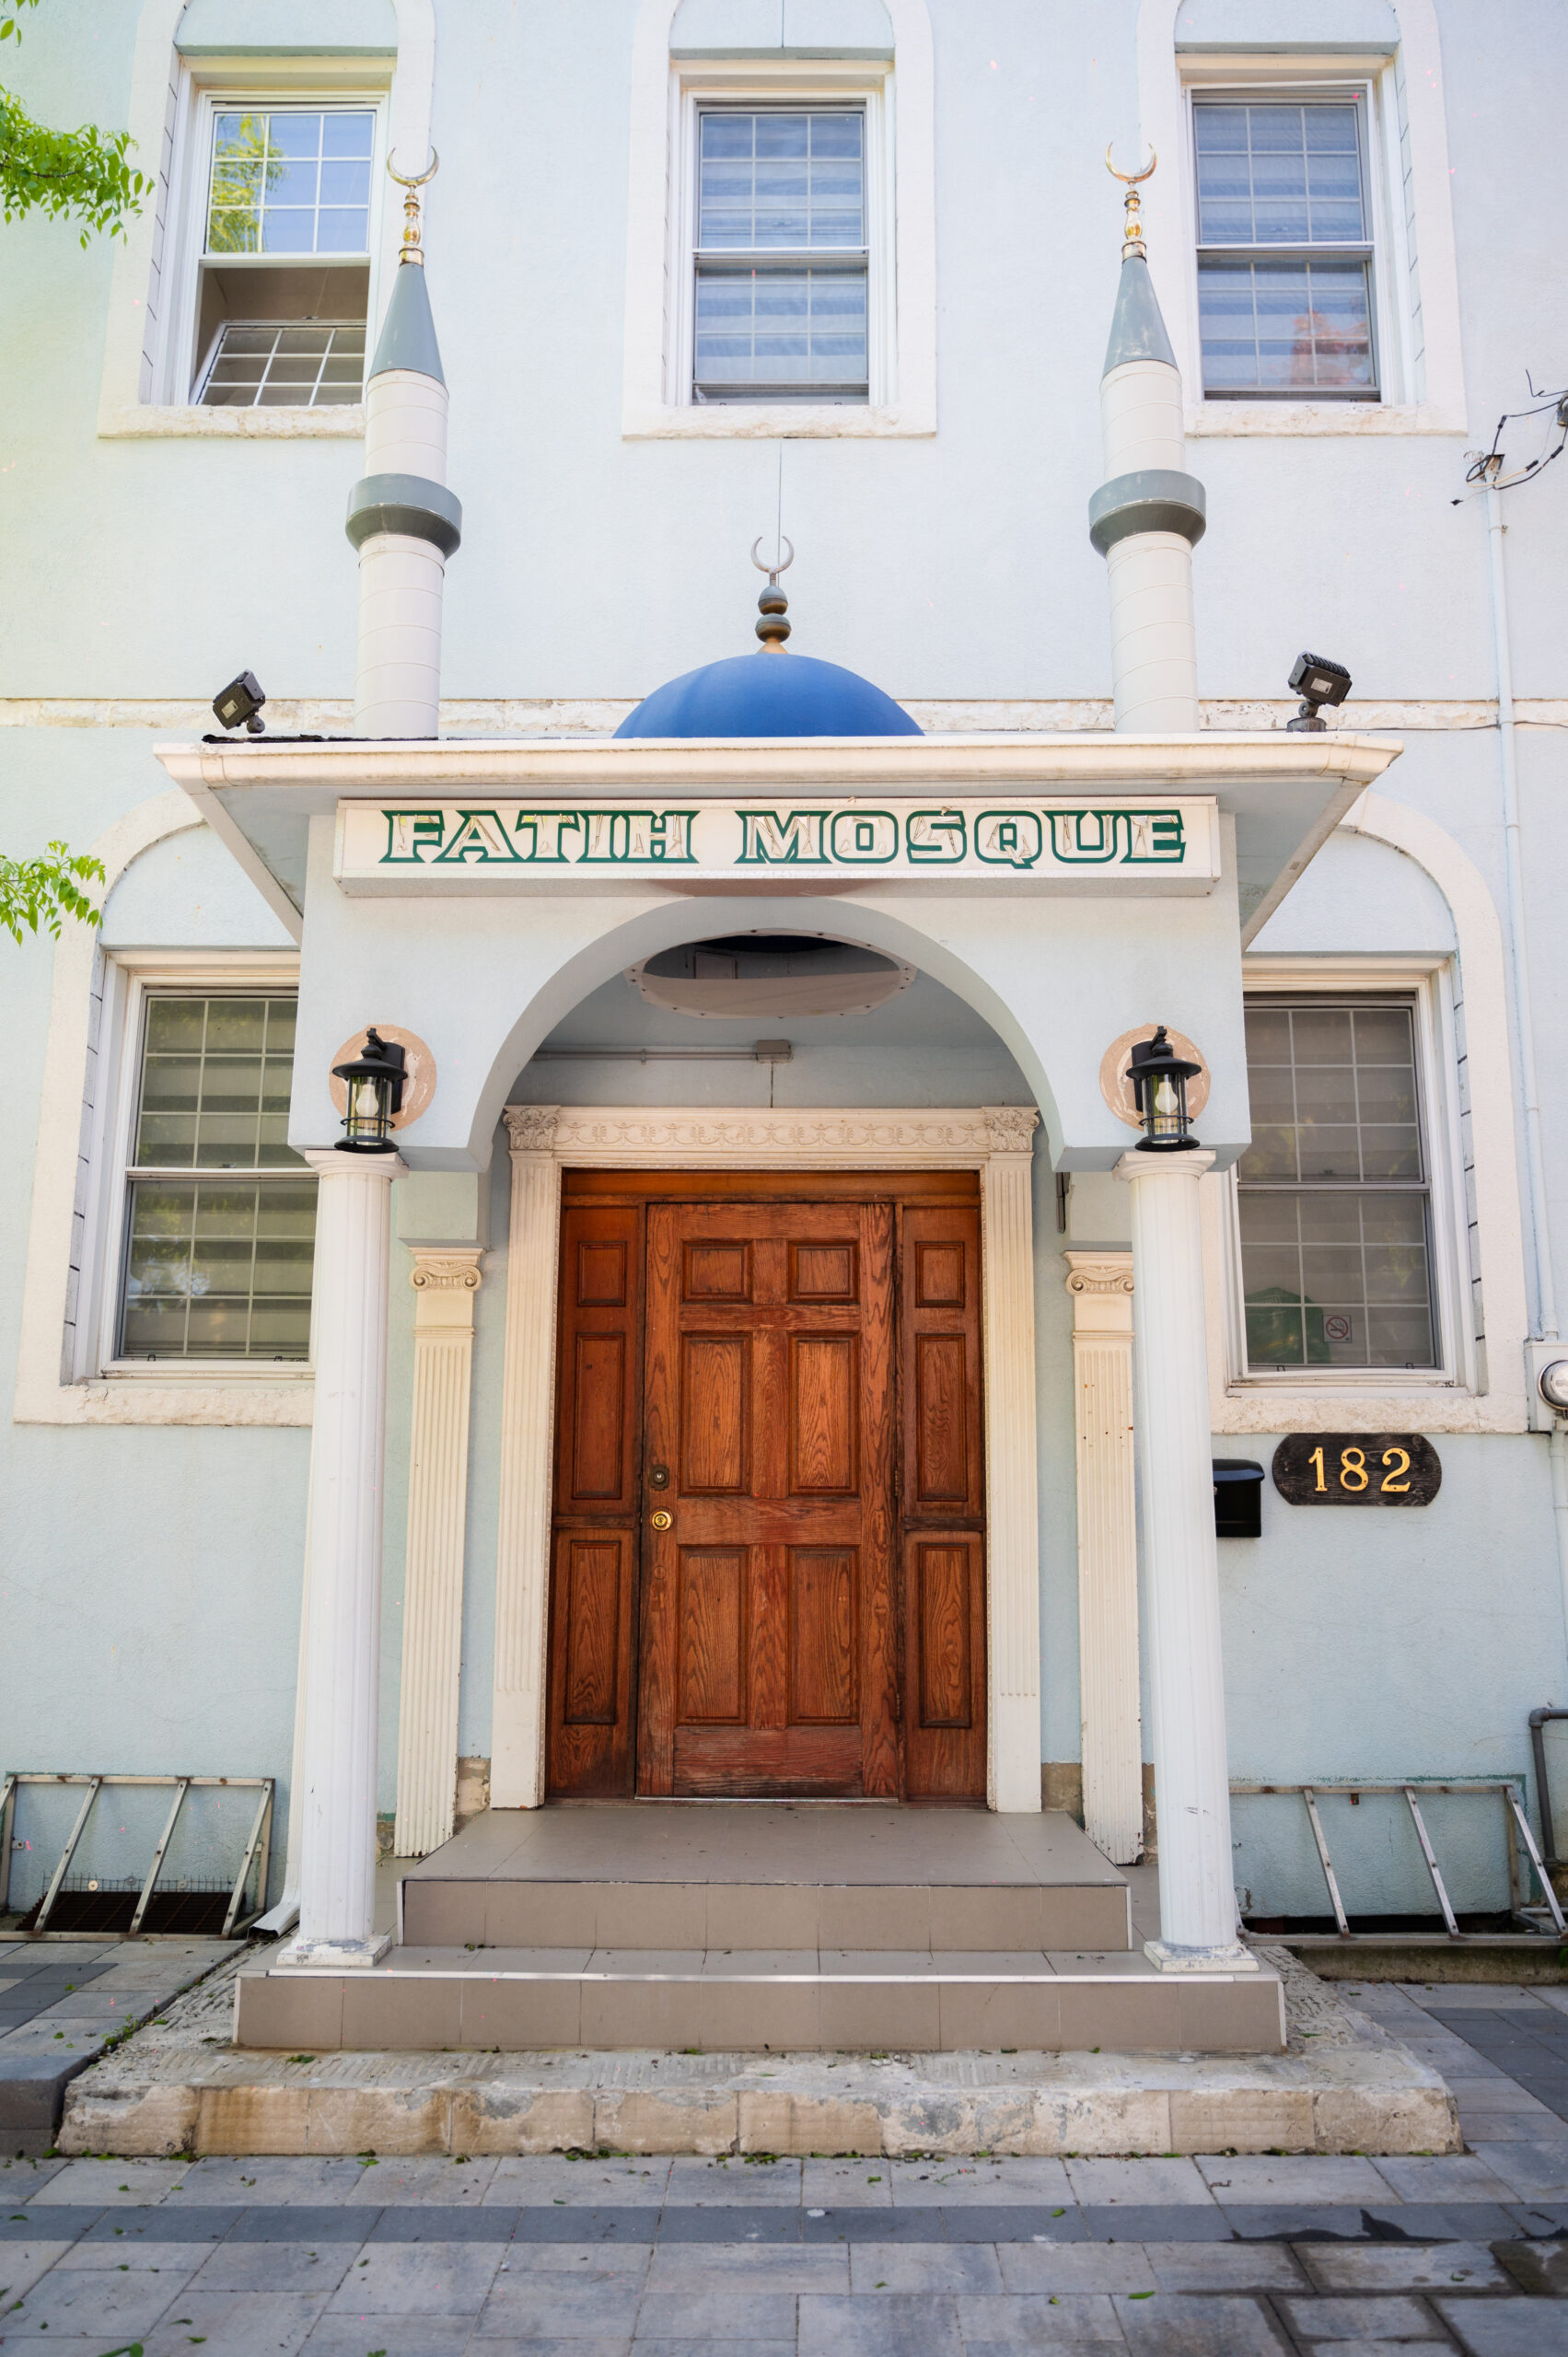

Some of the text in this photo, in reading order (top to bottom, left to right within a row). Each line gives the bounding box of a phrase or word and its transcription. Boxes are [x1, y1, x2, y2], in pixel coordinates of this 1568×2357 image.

[378, 810, 1185, 869] FATIH MOSQUE
[1308, 1446, 1411, 1492] 182
